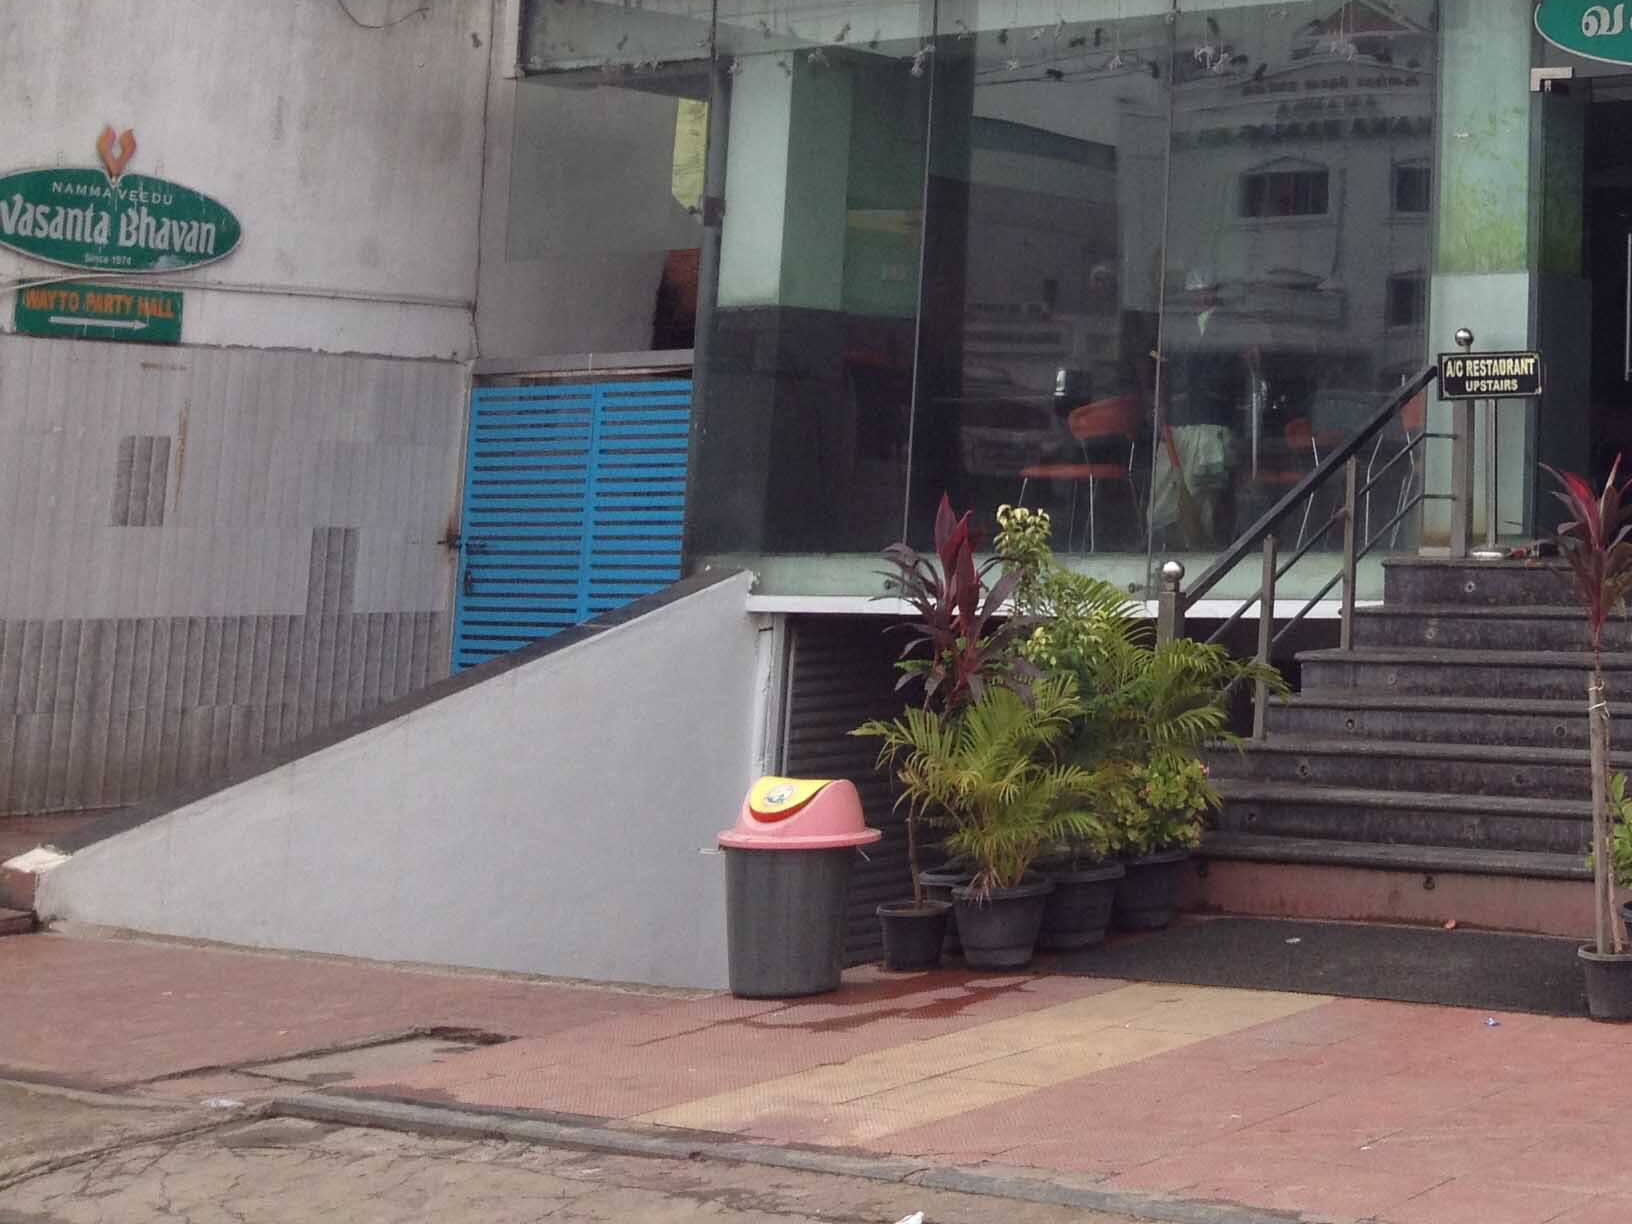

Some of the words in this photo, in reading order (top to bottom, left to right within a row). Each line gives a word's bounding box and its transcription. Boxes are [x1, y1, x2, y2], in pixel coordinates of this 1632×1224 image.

[53, 182, 111, 198] NAMMA
[119, 190, 173, 205] VEEDU
[0, 193, 112, 246] Vasanta
[118, 206, 215, 254] Bhavan
[1446, 360, 1463, 377] A/C
[1465, 358, 1535, 377] RESTAURANT
[1465, 378, 1518, 392] UPSTAIRS
